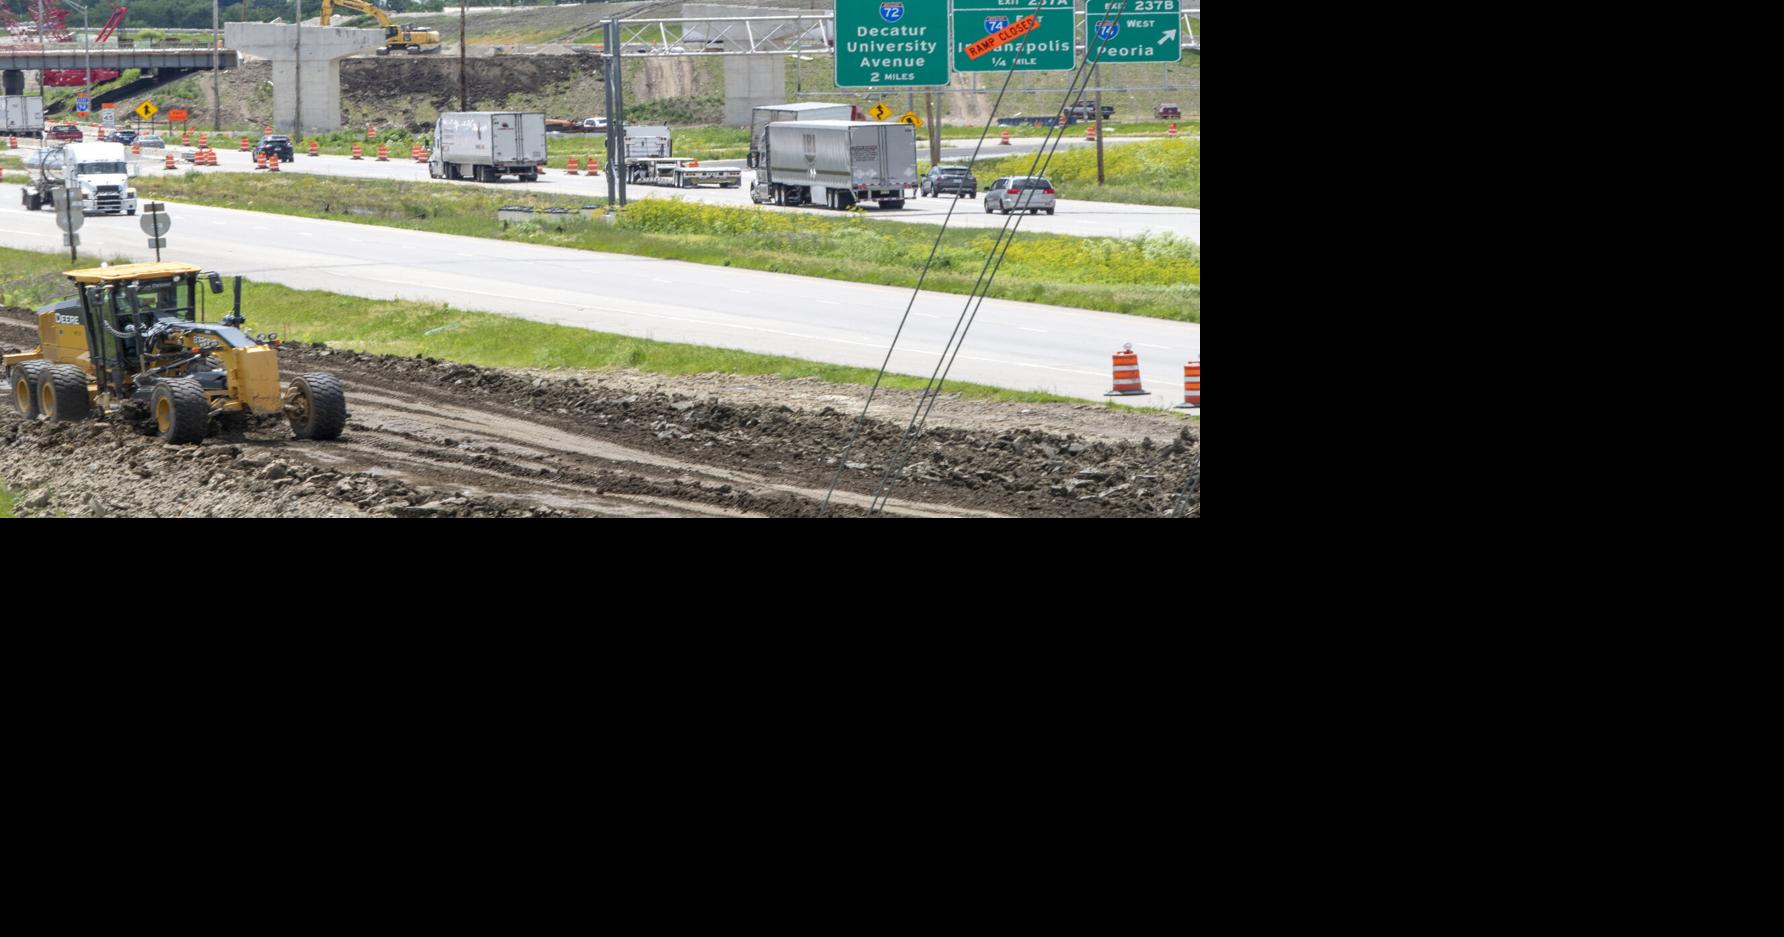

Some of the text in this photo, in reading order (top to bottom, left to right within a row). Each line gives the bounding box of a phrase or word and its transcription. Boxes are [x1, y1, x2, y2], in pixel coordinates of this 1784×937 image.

[1134, 0, 1174, 10] 237B
[884, 7, 900, 18] 72
[987, 21, 1004, 32] 74
[1126, 19, 1156, 28] WEST
[857, 26, 927, 37] Decatur
[847, 40, 937, 54] University
[968, 37, 995, 57] RAMP
[1097, 44, 1154, 57] Peoria
[860, 57, 926, 68] Avenue
[870, 72, 915, 82] 2 MILES
[55, 312, 80, 325] DEERE
